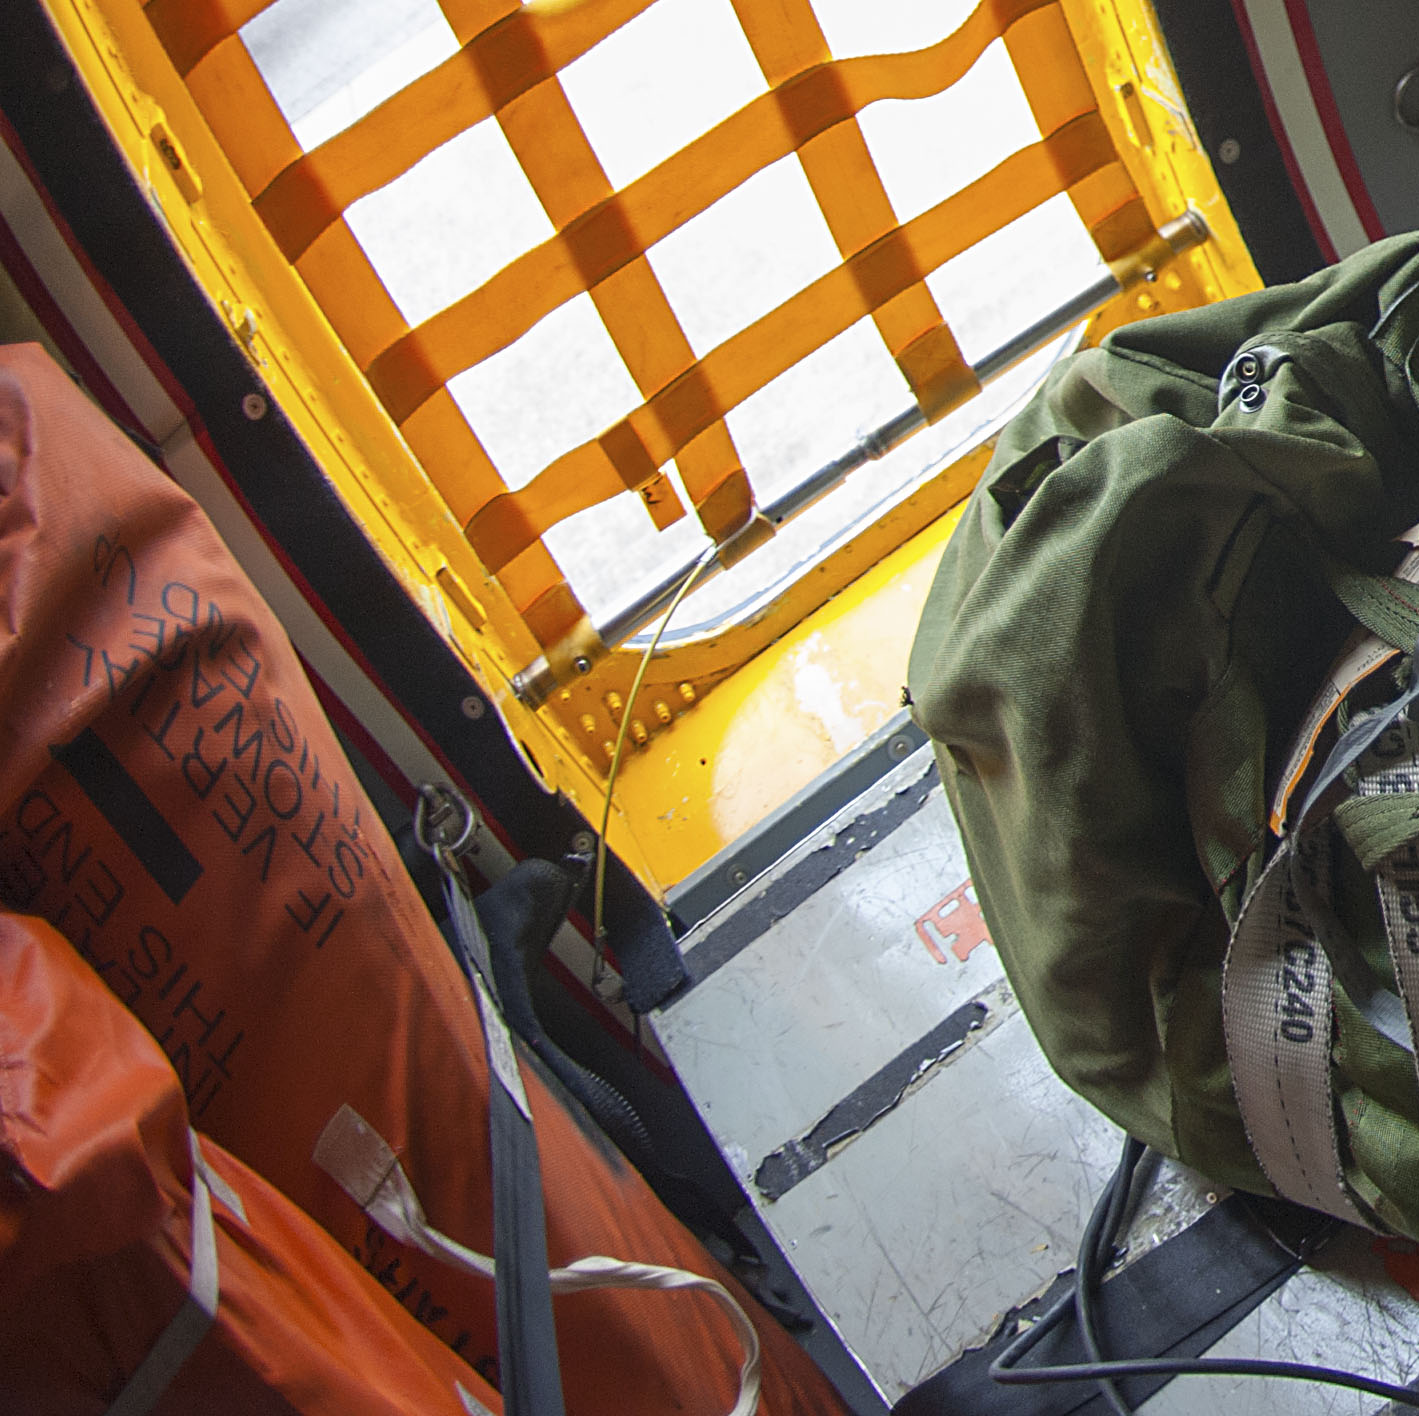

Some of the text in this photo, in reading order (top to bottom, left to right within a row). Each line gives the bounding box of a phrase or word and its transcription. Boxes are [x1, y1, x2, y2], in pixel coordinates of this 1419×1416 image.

[161, 582, 263, 700] END
[16, 787, 243, 1079] THIS END
[284, 889, 344, 950] IF
